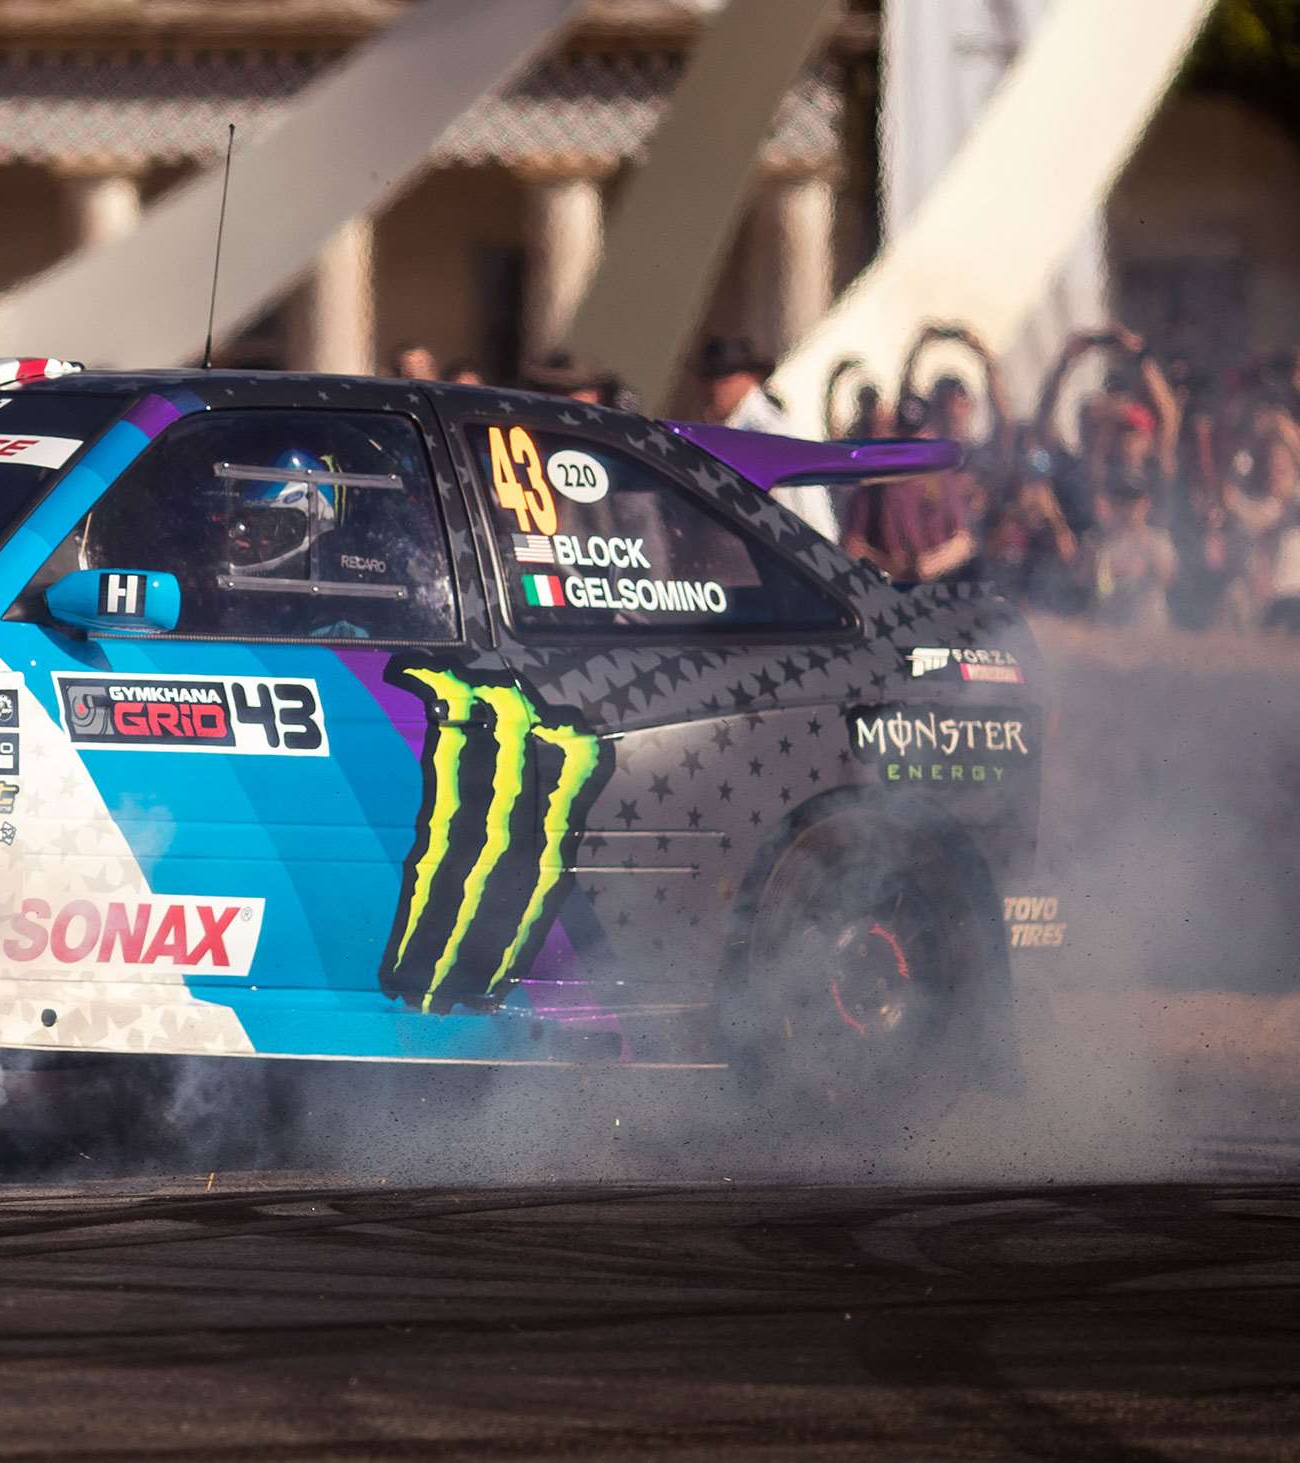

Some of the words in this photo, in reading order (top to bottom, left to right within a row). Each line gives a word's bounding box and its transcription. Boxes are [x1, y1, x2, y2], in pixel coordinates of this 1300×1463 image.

[488, 426, 557, 536] 43
[558, 464, 597, 488] 220
[340, 554, 388, 573] RECARO
[553, 535, 651, 569] BLOCK
[107, 574, 138, 613] H
[564, 575, 728, 614] GELSOMINO
[109, 686, 223, 704] GYMKHANA
[231, 682, 323, 749] 43
[886, 763, 1005, 781] ENERGY
[1003, 896, 1058, 921] TOYO
[3, 898, 241, 967] SONAX
